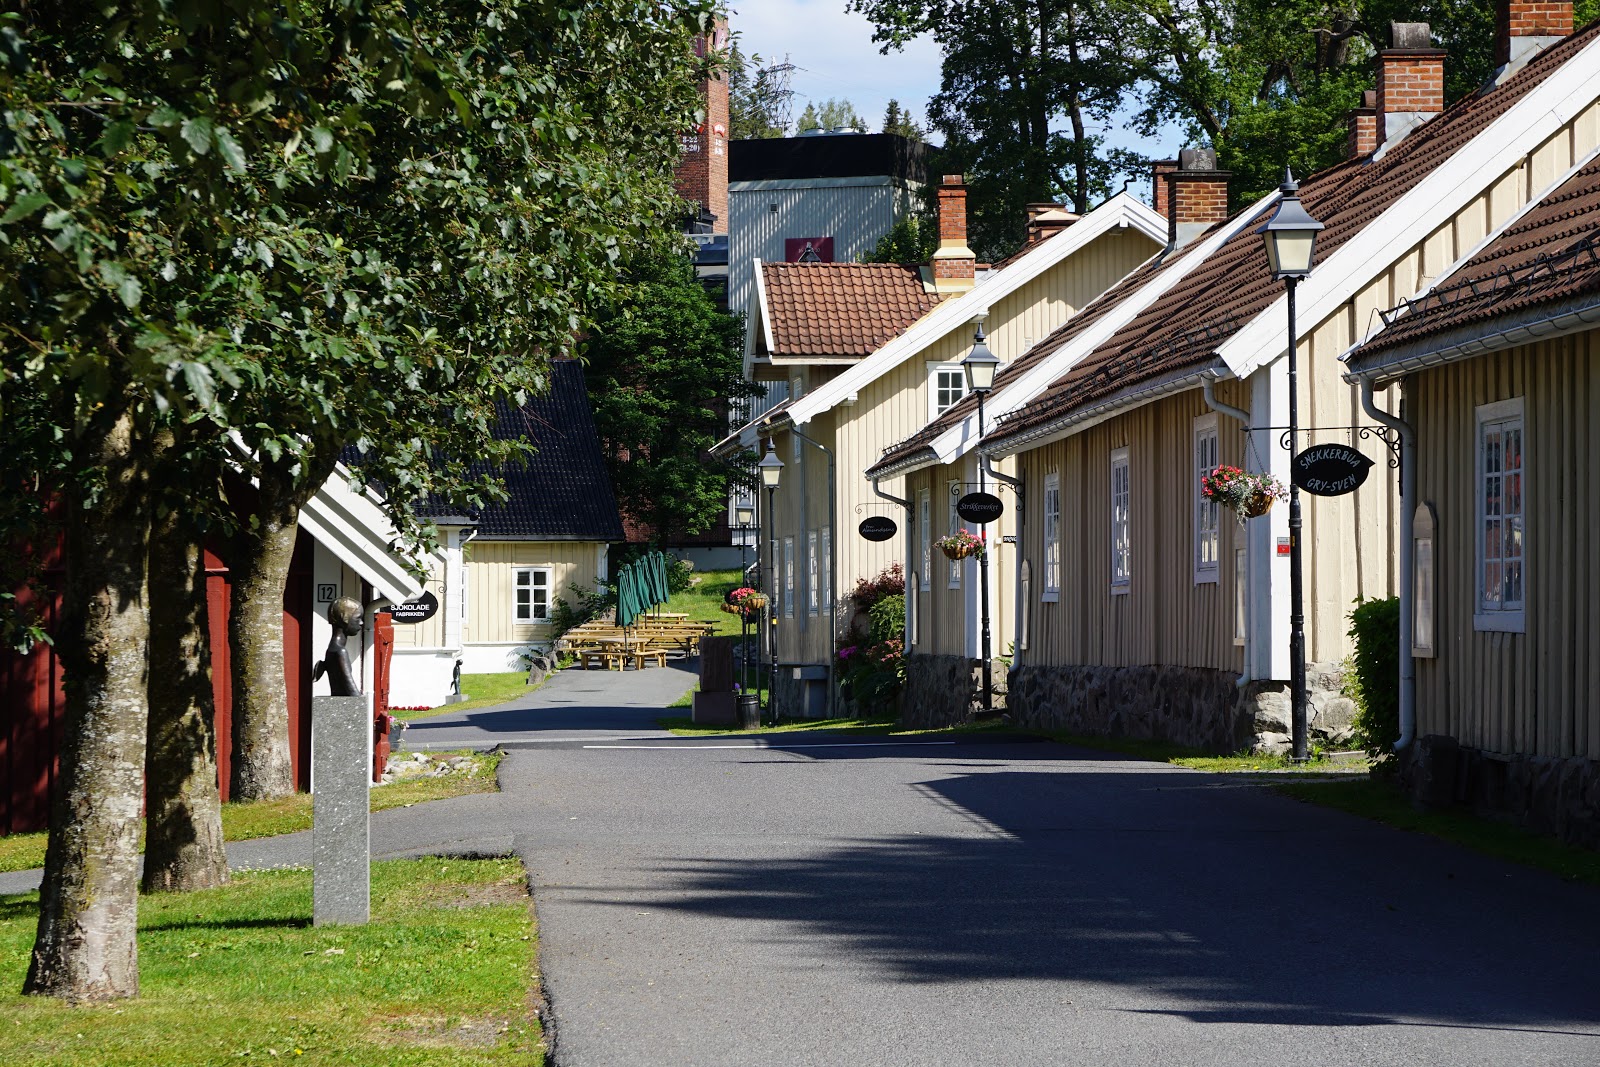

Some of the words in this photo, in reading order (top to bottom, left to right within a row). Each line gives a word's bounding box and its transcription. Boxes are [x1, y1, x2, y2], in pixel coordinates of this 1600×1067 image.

[1300, 448, 1360, 469] SNEKKERBUA
[1306, 474, 1356, 492] GRY-SVEN
[321, 587, 333, 600] 12
